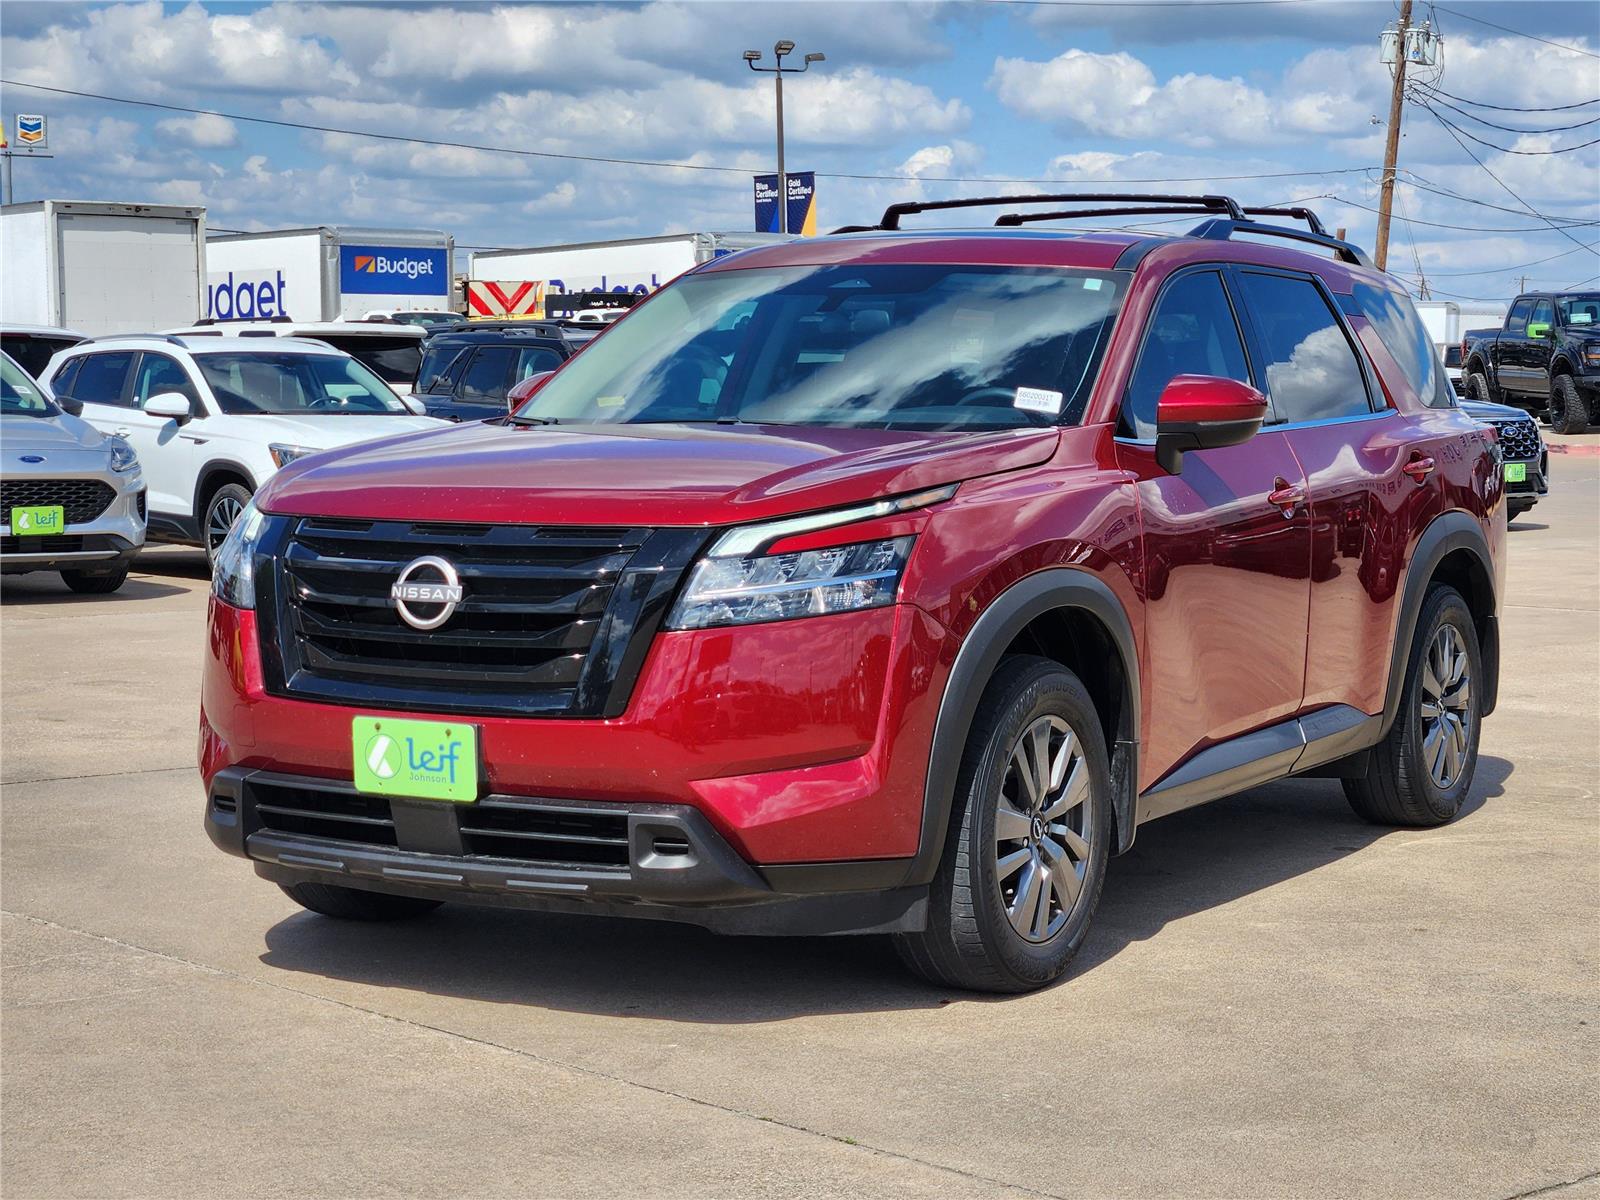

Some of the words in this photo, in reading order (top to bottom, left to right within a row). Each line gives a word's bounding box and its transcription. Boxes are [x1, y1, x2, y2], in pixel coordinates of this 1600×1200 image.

[788, 179, 801, 187] Gold
[756, 189, 778, 198] Certified
[788, 186, 812, 195] Certified
[377, 256, 433, 279] Budget
[34, 510, 59, 527] leif
[391, 586, 460, 600] NISSAN
[405, 737, 462, 784] leif
[409, 772, 447, 784] Johnson
